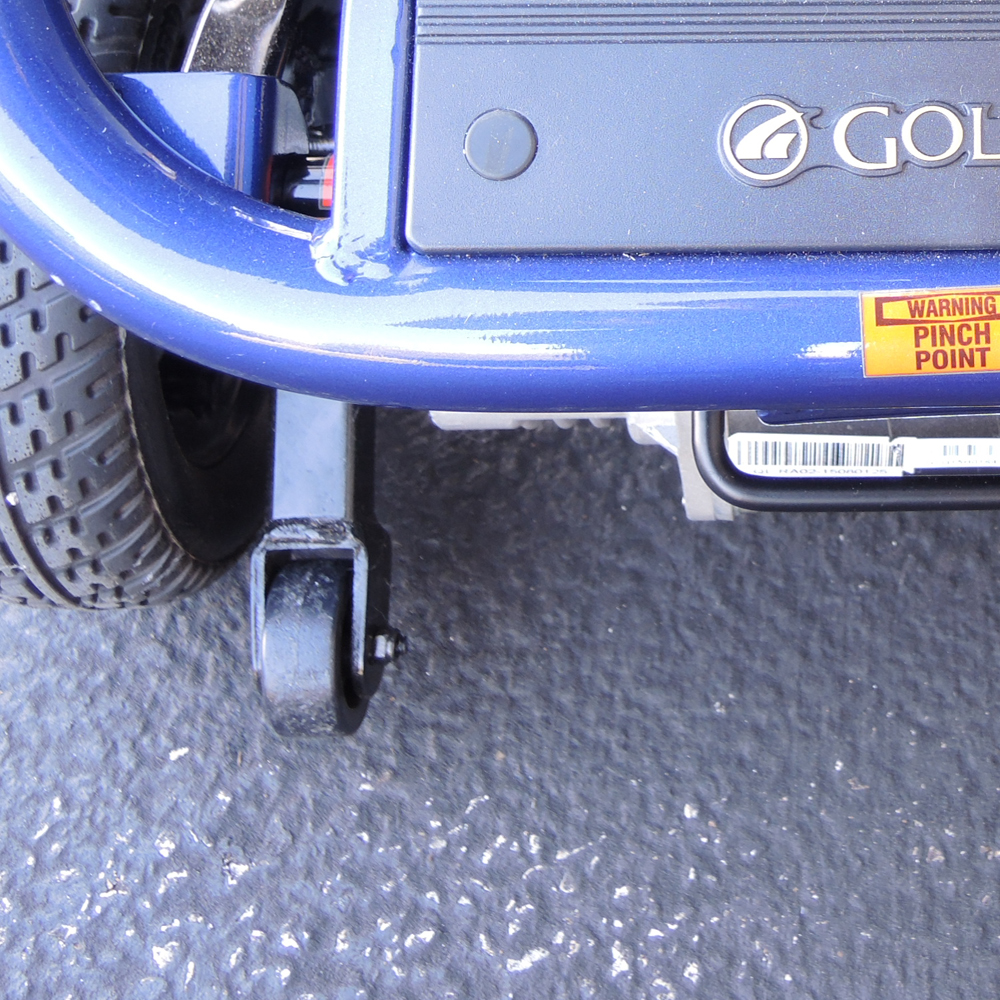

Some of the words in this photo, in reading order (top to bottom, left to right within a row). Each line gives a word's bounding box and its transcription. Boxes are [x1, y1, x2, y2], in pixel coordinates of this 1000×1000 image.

[907, 296, 997, 318] WARNING
[914, 322, 991, 348] PINCH
[915, 347, 991, 370] POINT
